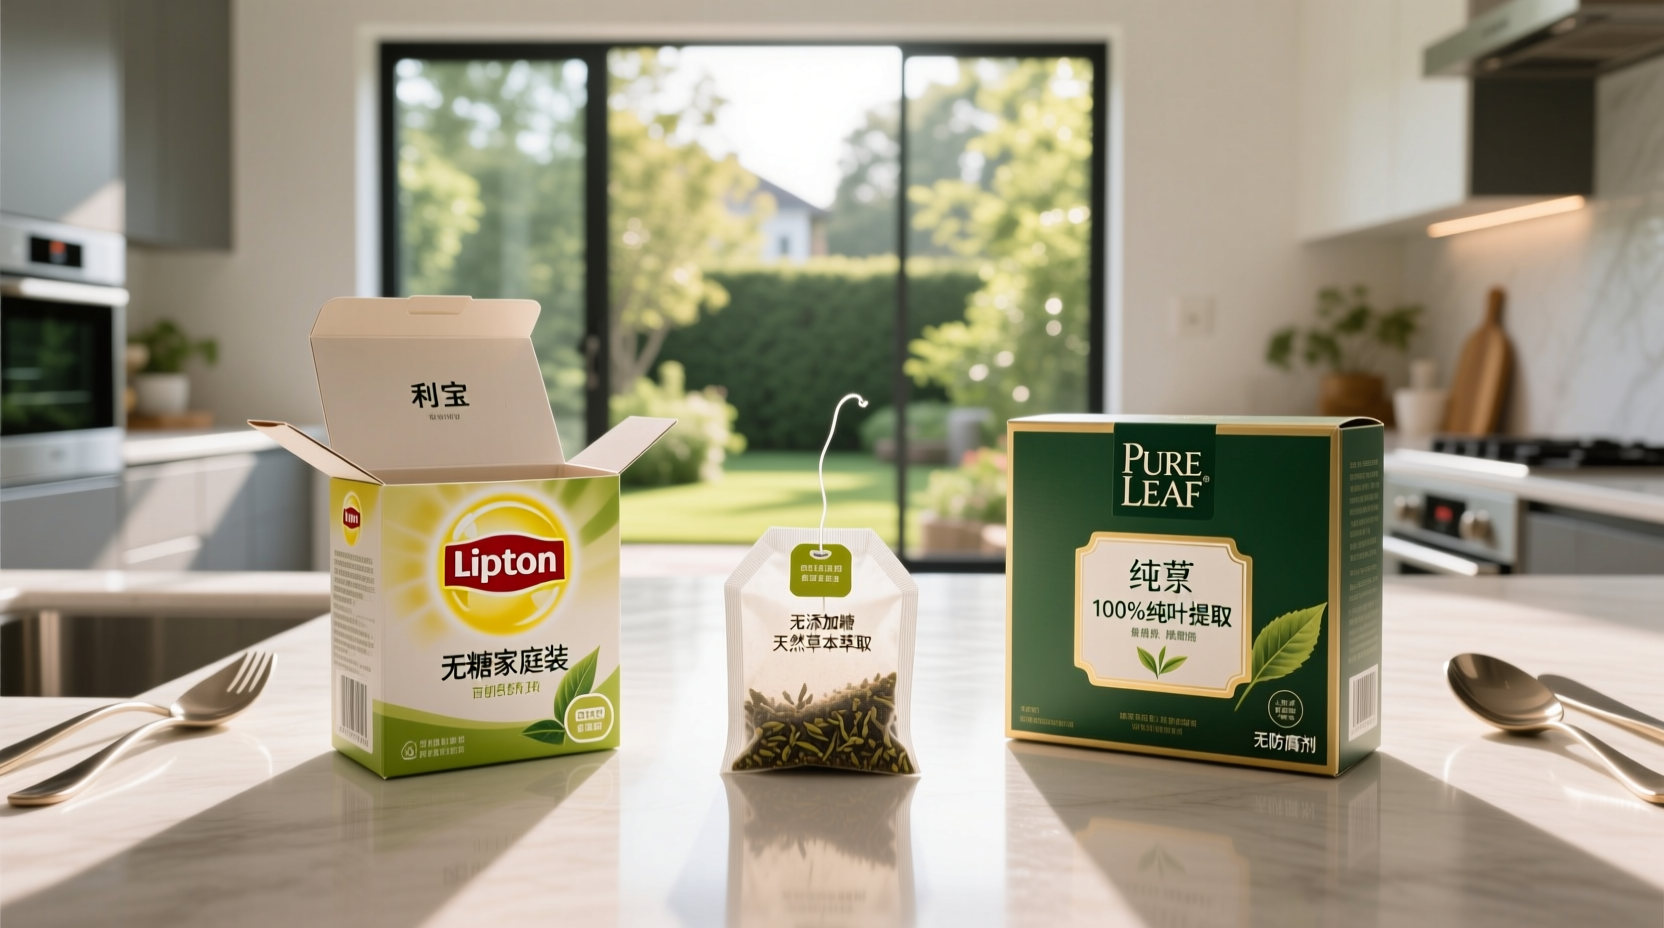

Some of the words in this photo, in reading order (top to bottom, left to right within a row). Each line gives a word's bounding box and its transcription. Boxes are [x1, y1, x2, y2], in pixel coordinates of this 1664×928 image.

[411, 381, 470, 409] 利宝
[1122, 442, 1202, 476] PURE
[454, 548, 556, 584] Lipton
[790, 612, 855, 631] 无添加糖
[1092, 599, 1232, 628] 100%纯叶提取
[441, 643, 569, 681] 无糖家庭装
